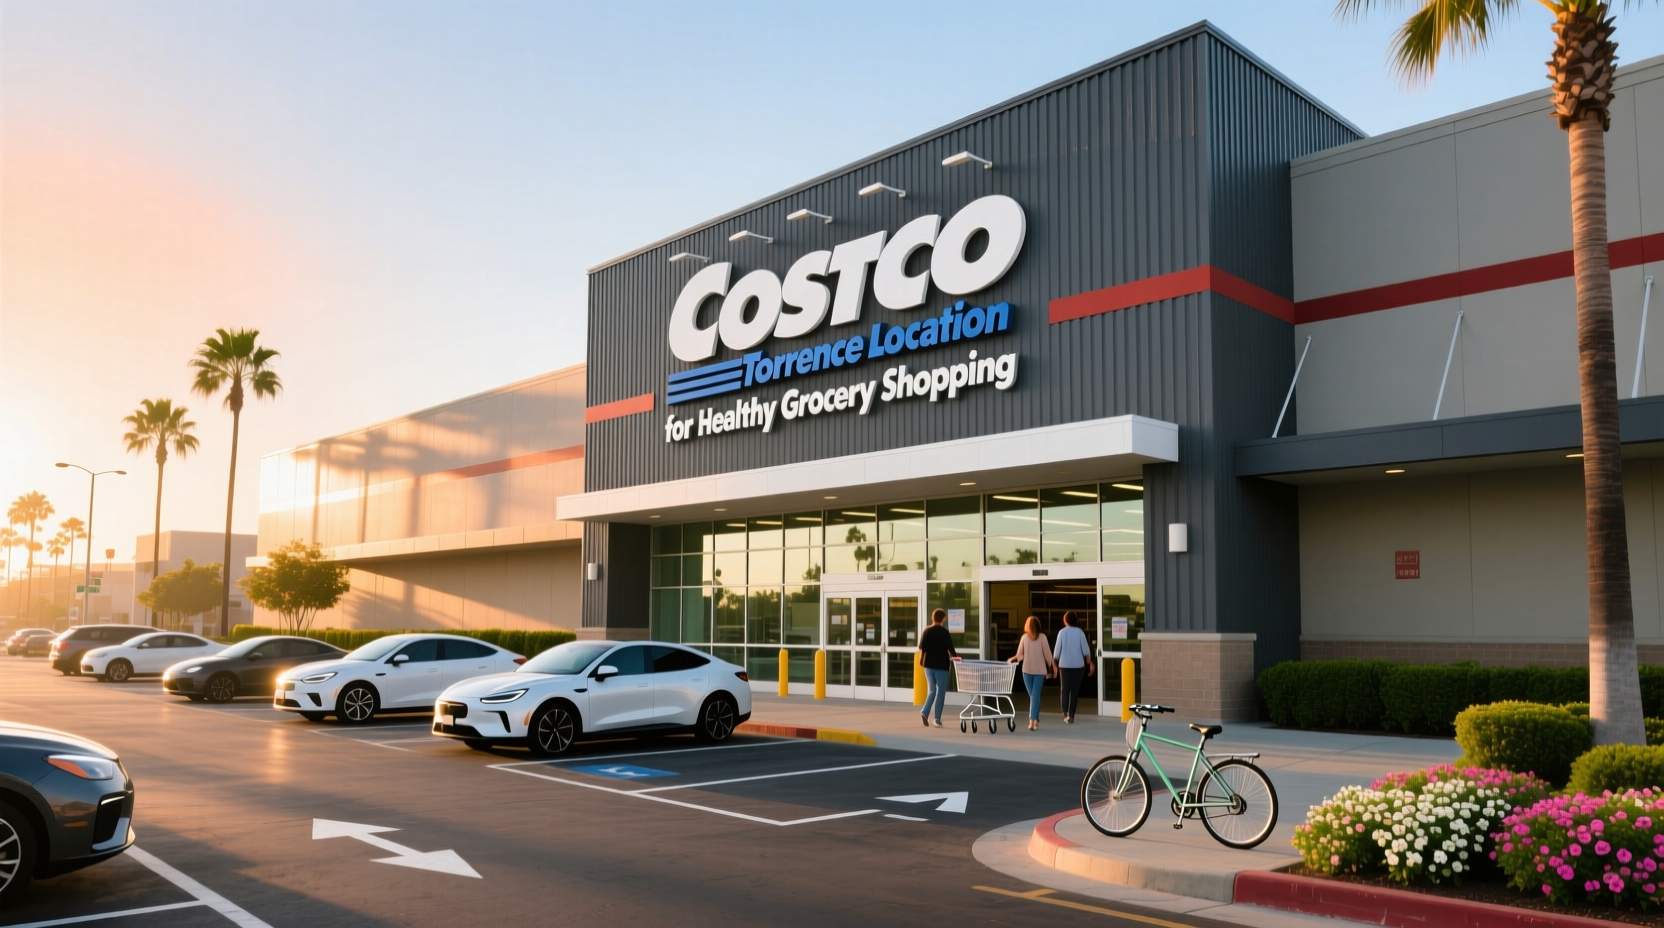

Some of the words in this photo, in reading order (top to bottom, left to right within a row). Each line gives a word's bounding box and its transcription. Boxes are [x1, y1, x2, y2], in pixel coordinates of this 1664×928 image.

[668, 194, 1026, 362] COSTCO
[741, 335, 868, 387] Torrence
[867, 301, 1013, 359] Location
[665, 414, 694, 443] for
[698, 397, 777, 436] Healthy
[781, 380, 876, 419] Grocery
[881, 350, 1018, 402] Shopping
